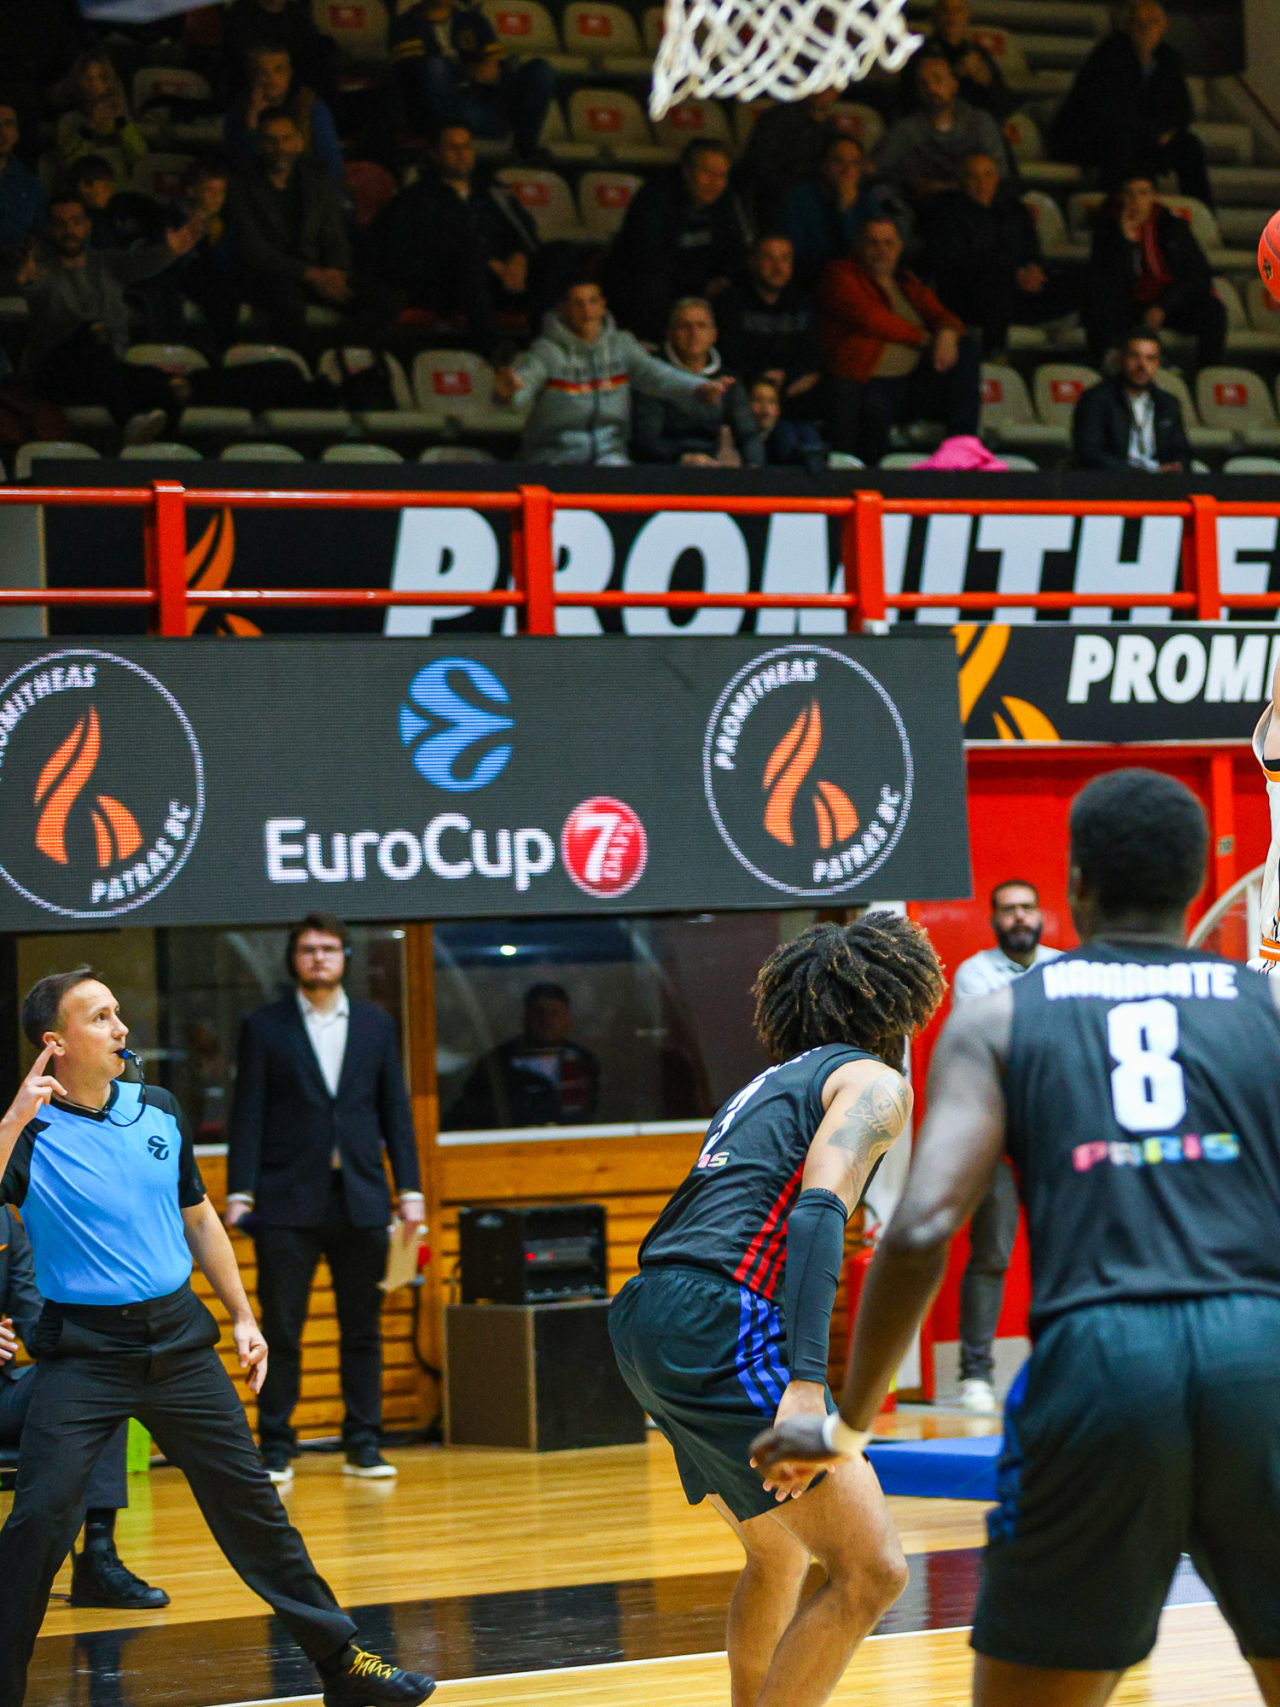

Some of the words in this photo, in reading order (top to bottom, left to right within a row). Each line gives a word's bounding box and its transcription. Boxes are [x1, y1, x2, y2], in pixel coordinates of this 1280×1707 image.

[0, 663, 98, 768] MITHEAS
[714, 658, 818, 770] PROMITHEAS
[90, 836, 176, 904] PATRAS
[264, 812, 556, 891] EuroCup
[1107, 998, 1187, 1132] 8
